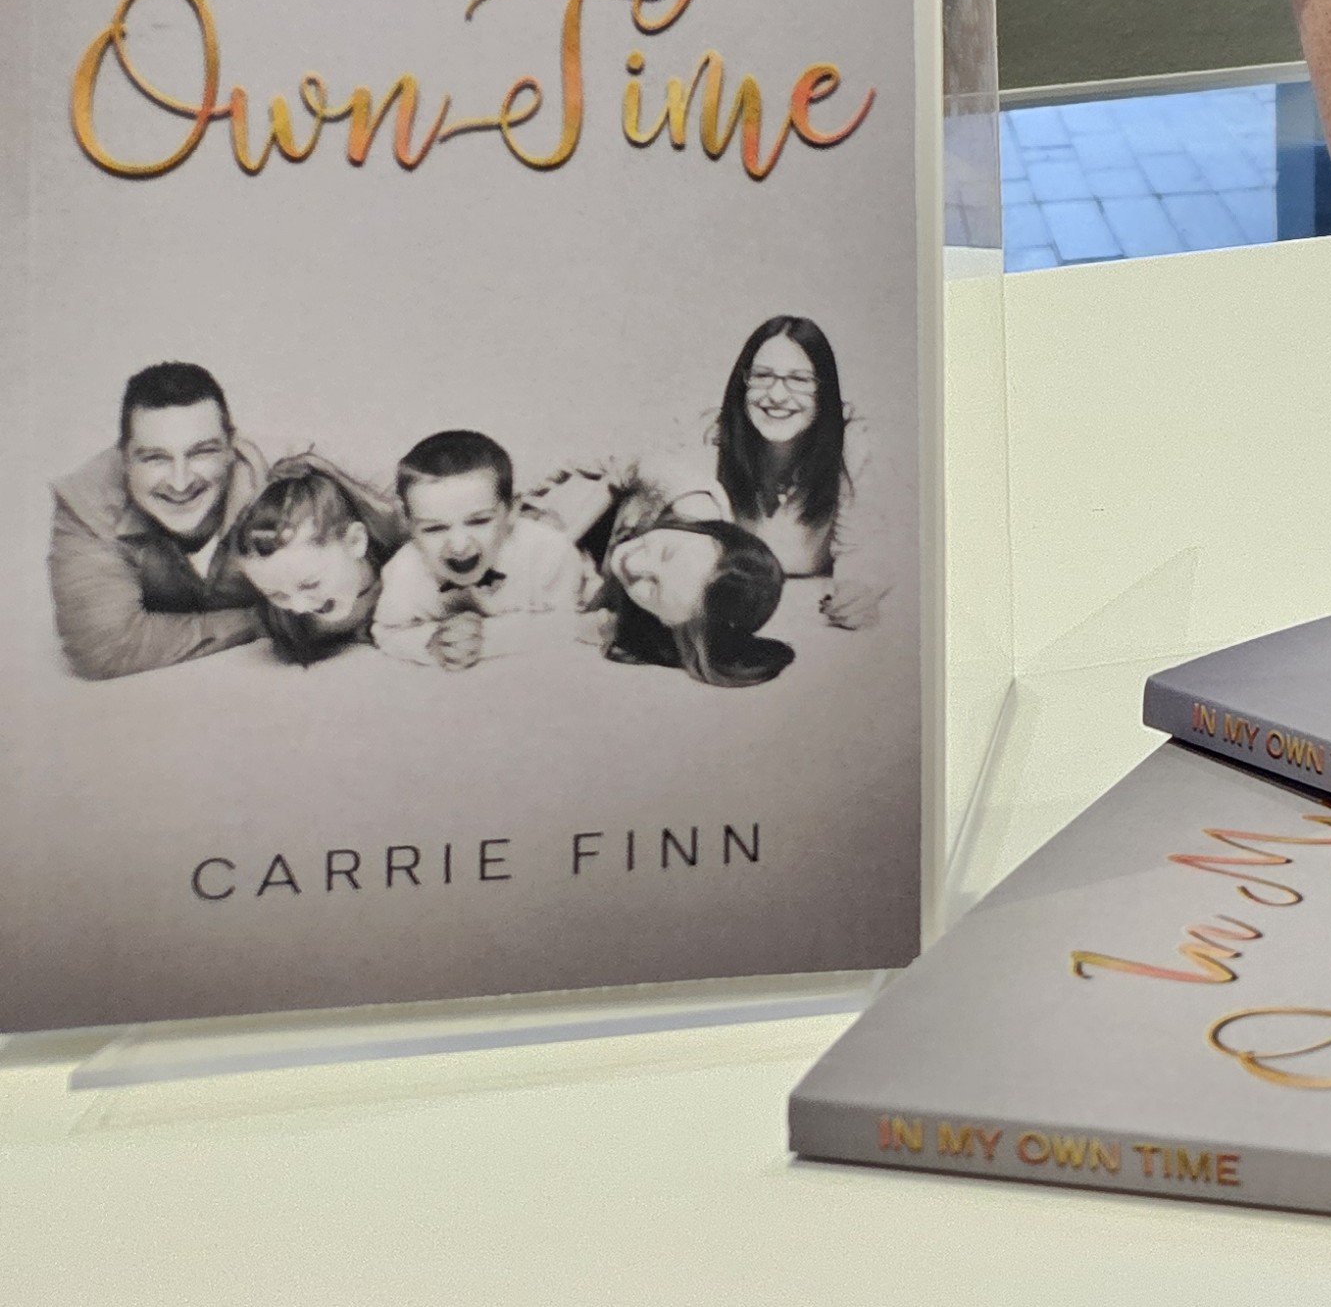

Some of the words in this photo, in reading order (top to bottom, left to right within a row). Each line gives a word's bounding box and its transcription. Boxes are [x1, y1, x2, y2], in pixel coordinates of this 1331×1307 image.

[1192, 702, 1217, 738] IN
[1224, 713, 1260, 751] MY
[1266, 728, 1326, 775] OWN
[191, 838, 513, 901] CARRIE
[572, 823, 761, 875] FINN
[879, 1115, 925, 1153] IN
[937, 1121, 1002, 1160] MY
[1015, 1130, 1122, 1175] OWN
[1132, 1145, 1242, 1187] TIME
